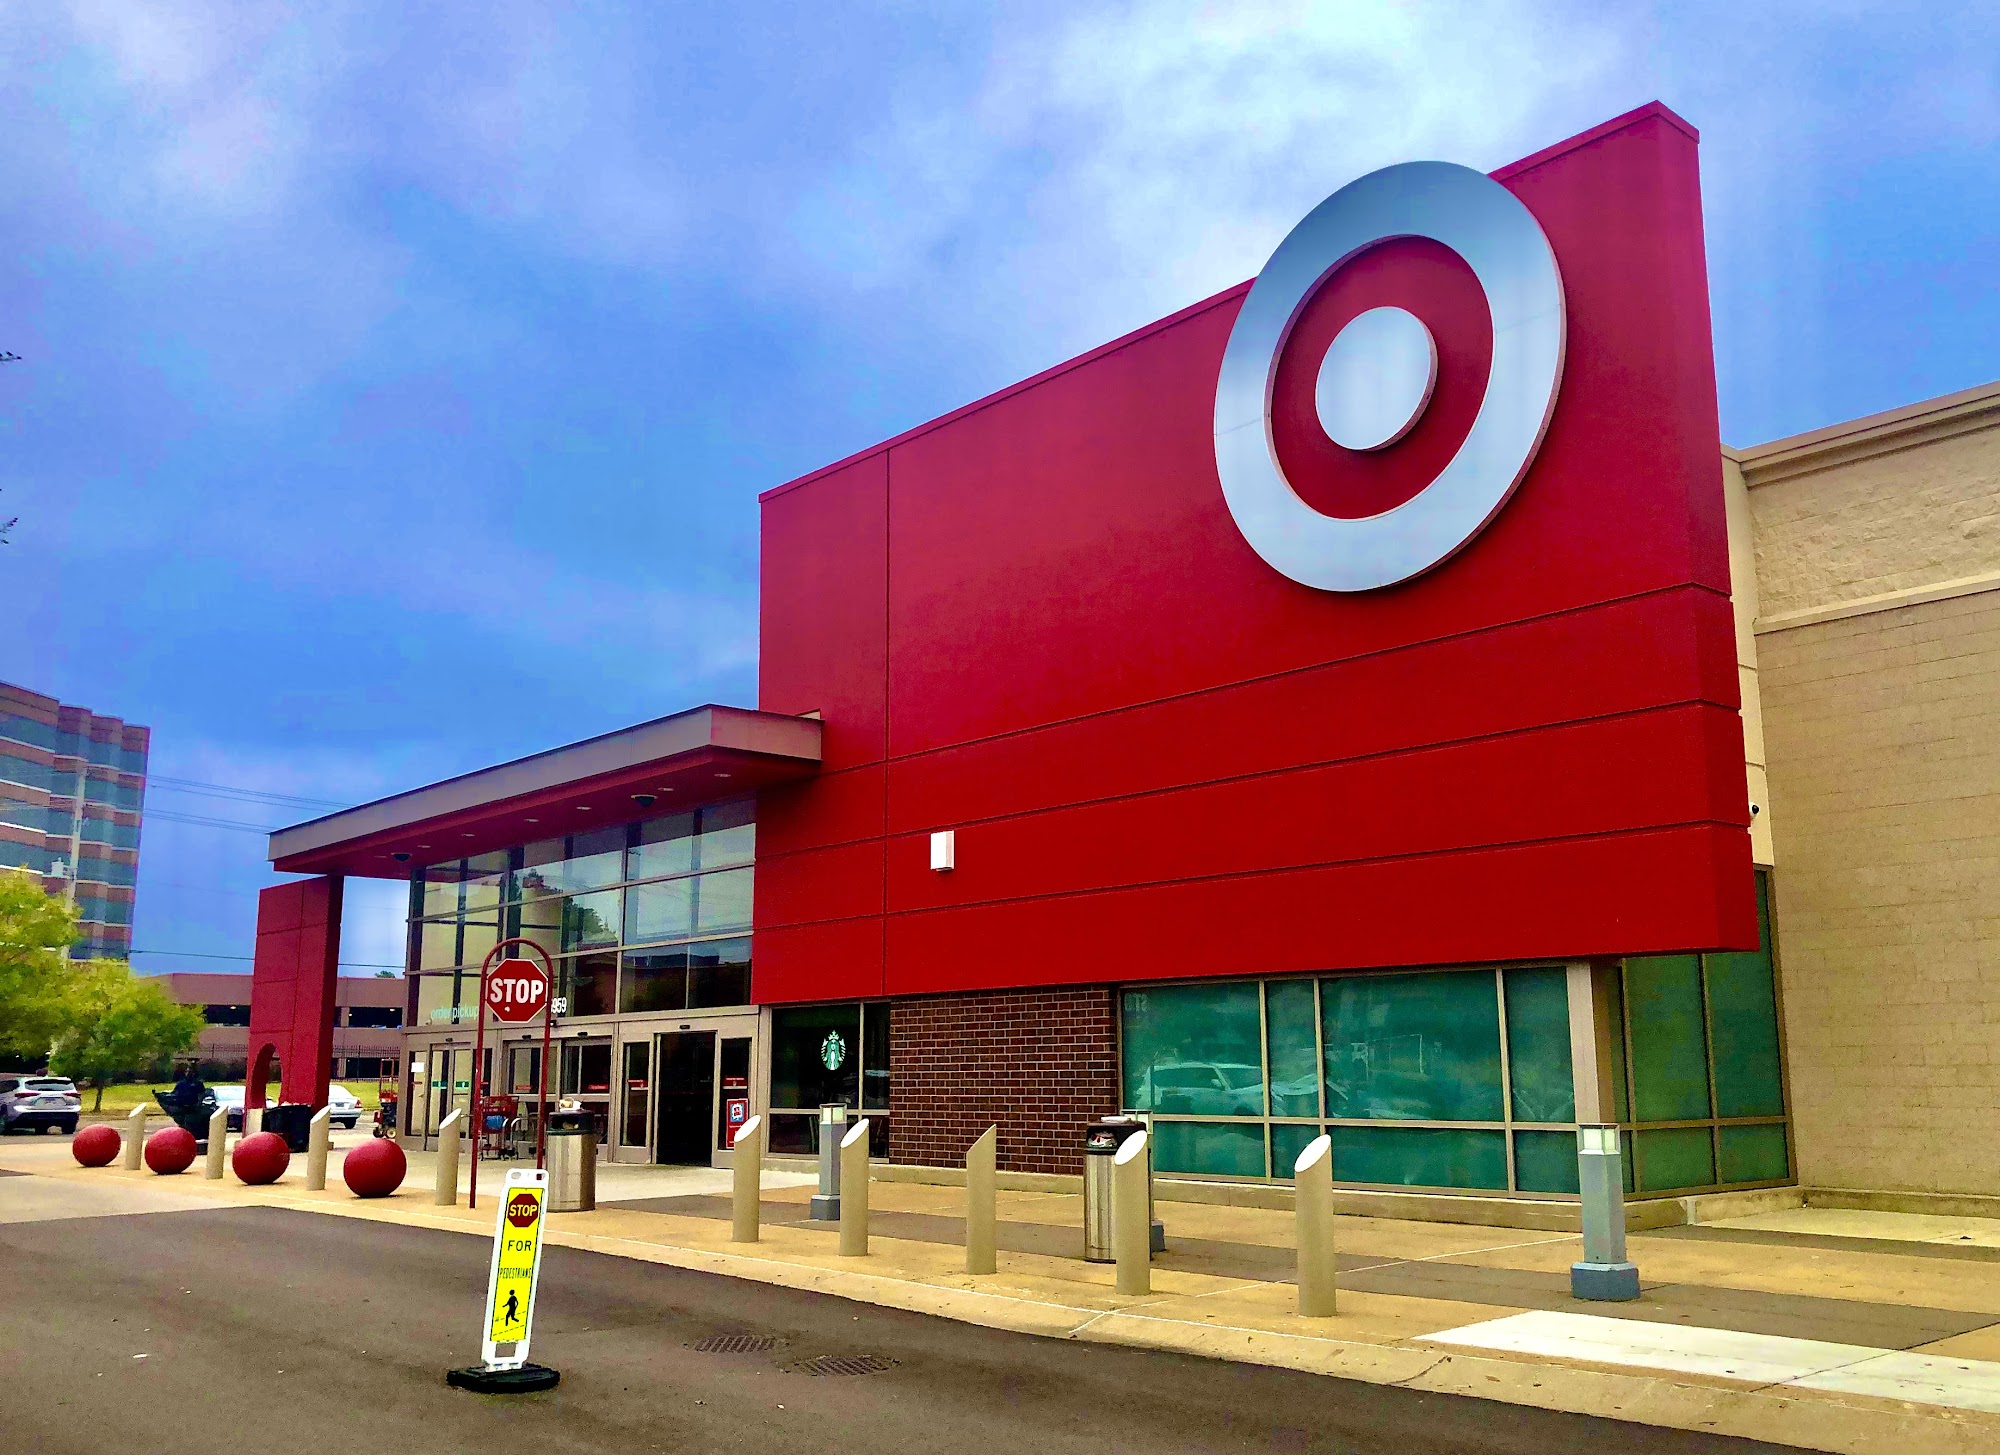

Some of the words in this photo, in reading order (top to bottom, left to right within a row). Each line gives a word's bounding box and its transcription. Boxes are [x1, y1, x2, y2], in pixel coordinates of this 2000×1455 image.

[490, 977, 544, 1004] STOP
[452, 1003, 480, 1022] pickup
[509, 1204, 538, 1217] STOP
[507, 1240, 532, 1252] FOR
[499, 1267, 532, 1279] PEDESTRIANS
